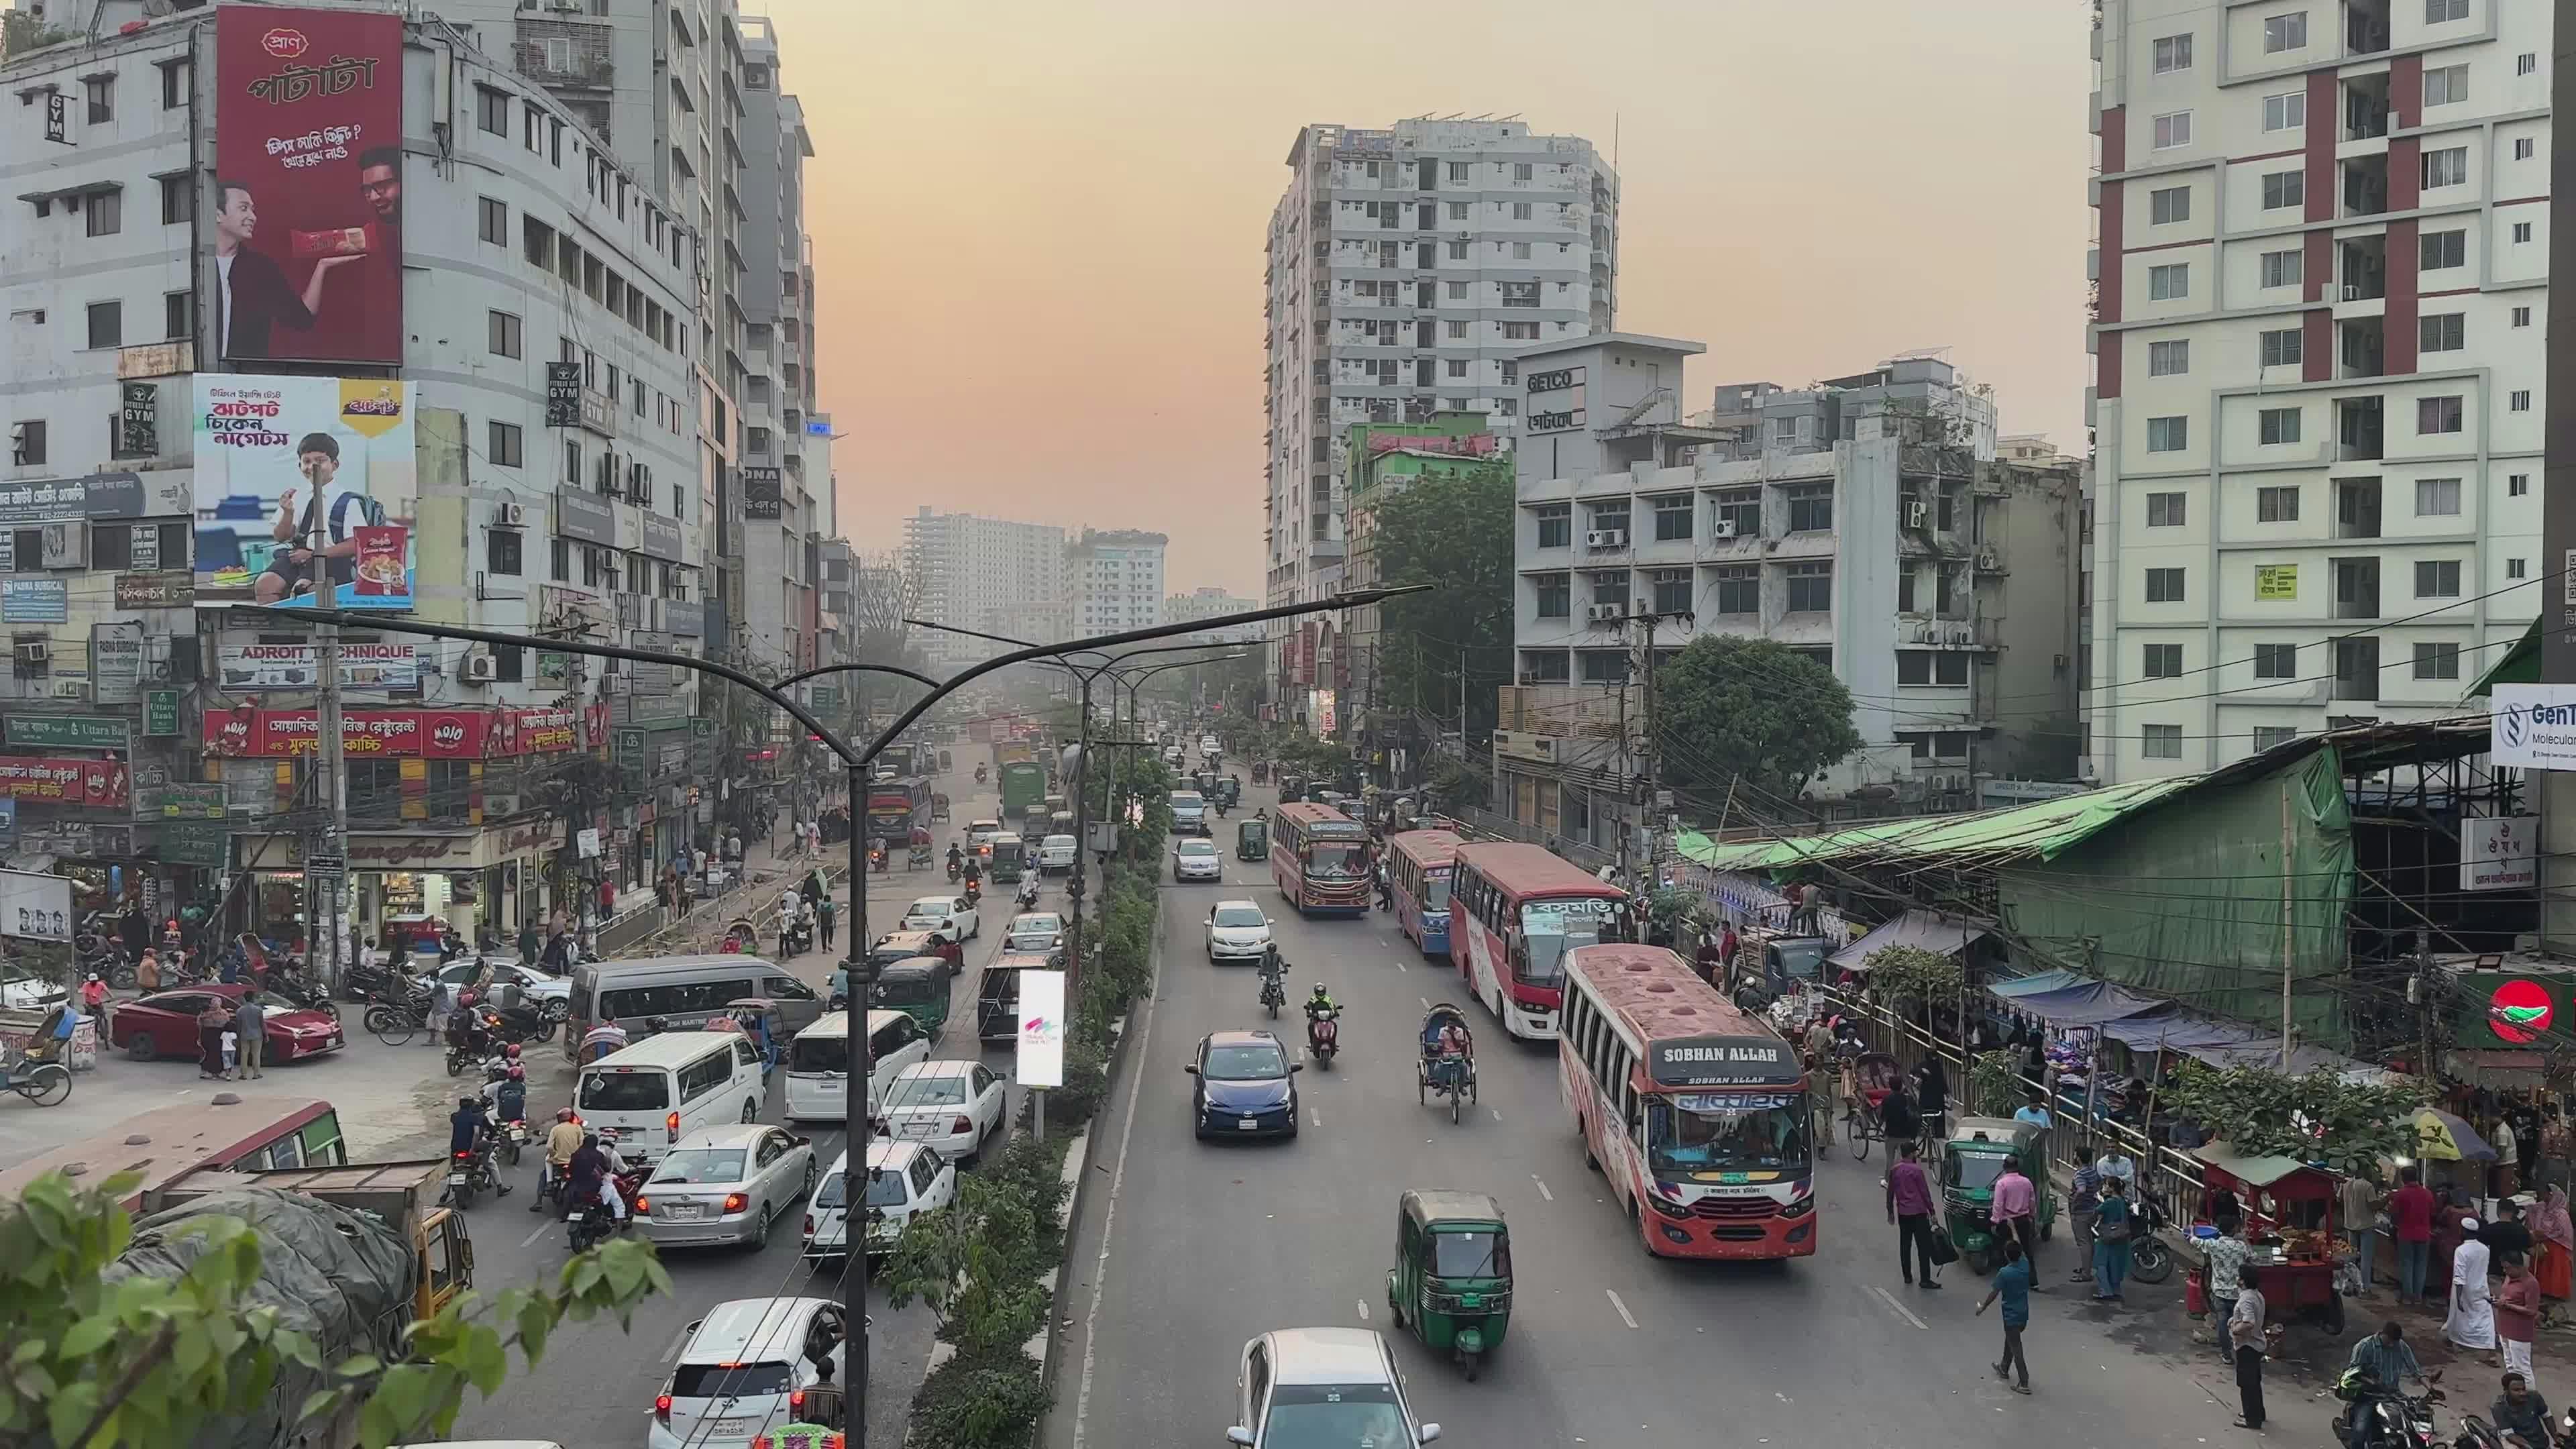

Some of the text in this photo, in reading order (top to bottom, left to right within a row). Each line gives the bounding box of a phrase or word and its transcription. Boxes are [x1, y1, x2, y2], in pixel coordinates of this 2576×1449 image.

[268, 36, 301, 50] প্রাণ
[247, 54, 380, 104] পটাটা
[50, 96, 62, 135] GYM
[1528, 371, 1572, 392] GETCO
[549, 388, 578, 398] GYM
[125, 409, 154, 422] GYM
[211, 400, 280, 417] ঝটপট
[204, 413, 262, 431] চিকেন
[1527, 409, 1572, 431] গেটকো
[213, 430, 289, 447] নাগেটস
[150, 702, 176, 711] Uttara
[152, 712, 173, 720] Bank
[83, 724, 109, 736] Uttara
[269, 717, 319, 733] সোয়াদিক
[433, 726, 464, 741] MOJO
[2532, 733, 2576, 747] Molecular
[1534, 898, 1613, 914] বসুমতি
[1664, 1047, 1778, 1063] SOBHAN ALLAH
[1688, 1077, 1730, 1085] SOBHAN
